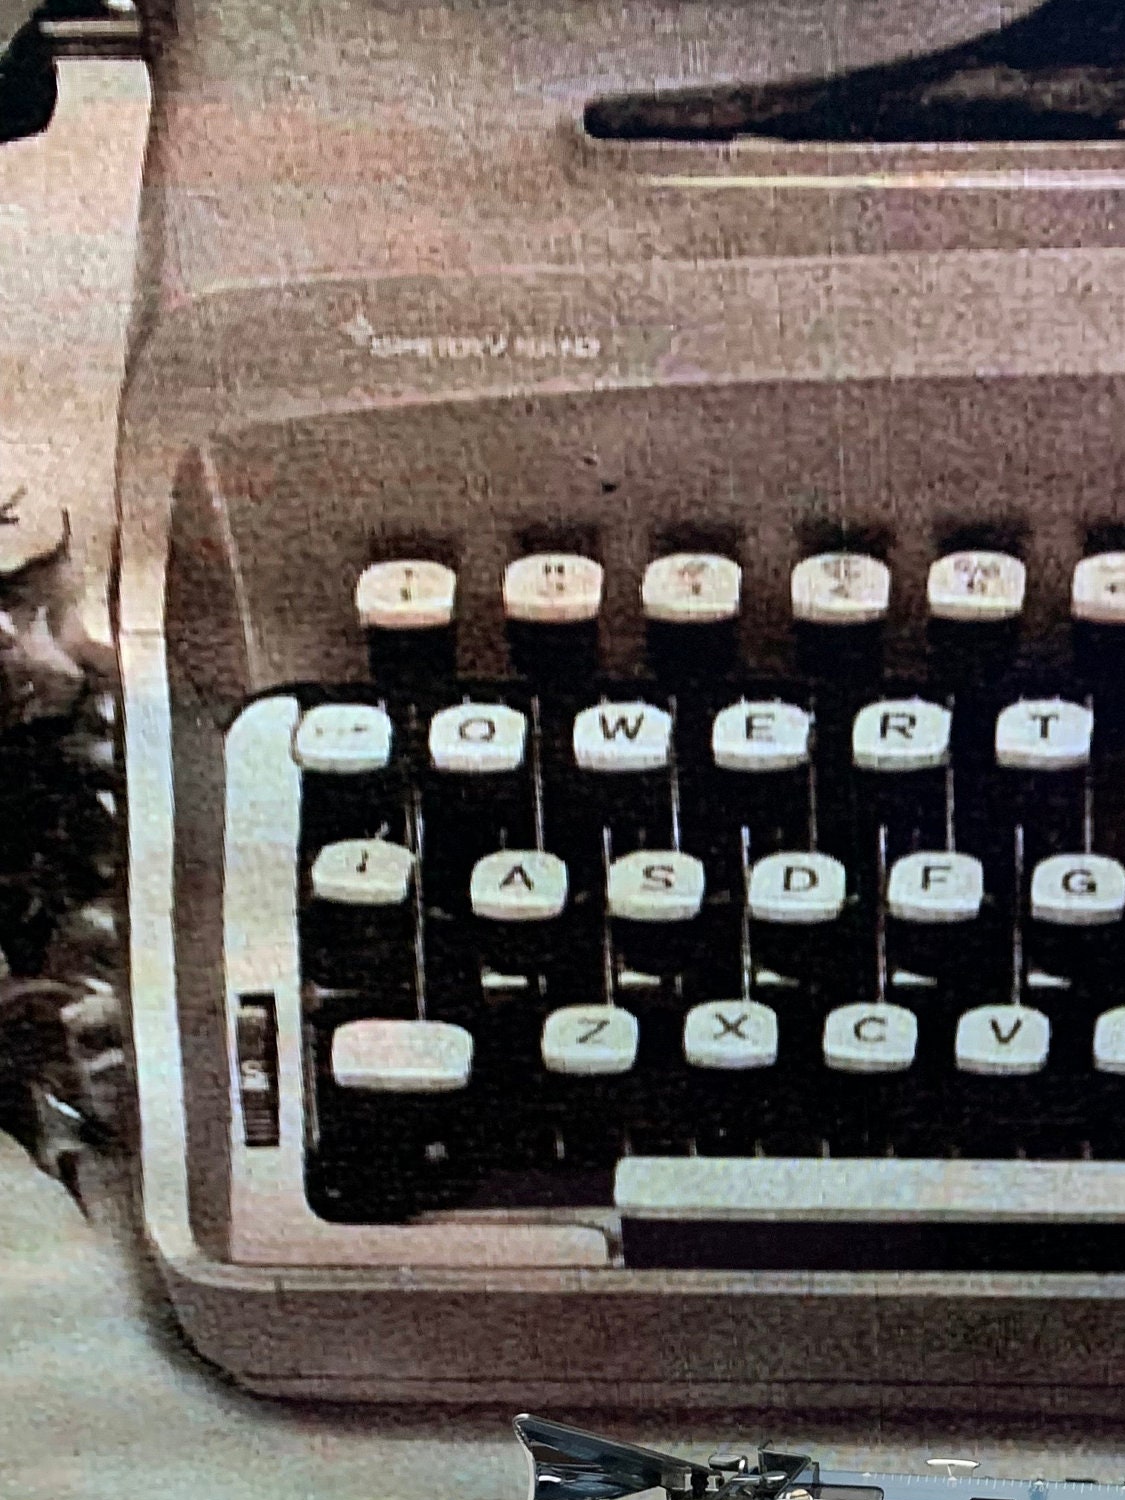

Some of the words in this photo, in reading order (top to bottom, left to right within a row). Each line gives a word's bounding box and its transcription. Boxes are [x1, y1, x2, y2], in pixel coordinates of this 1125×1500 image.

[458, 718, 496, 743] Q
[598, 713, 645, 741] W
[745, 714, 773, 740] E
[879, 712, 917, 739] R
[1031, 714, 1059, 739] T
[499, 863, 535, 892] A
[642, 864, 675, 890] S
[783, 865, 819, 892] D
[921, 865, 951, 891] F
[1061, 868, 1097, 894] G
[575, 1018, 611, 1044] Z
[713, 1013, 749, 1040] X
[853, 1015, 886, 1042] C
[990, 1018, 1023, 1045] V
